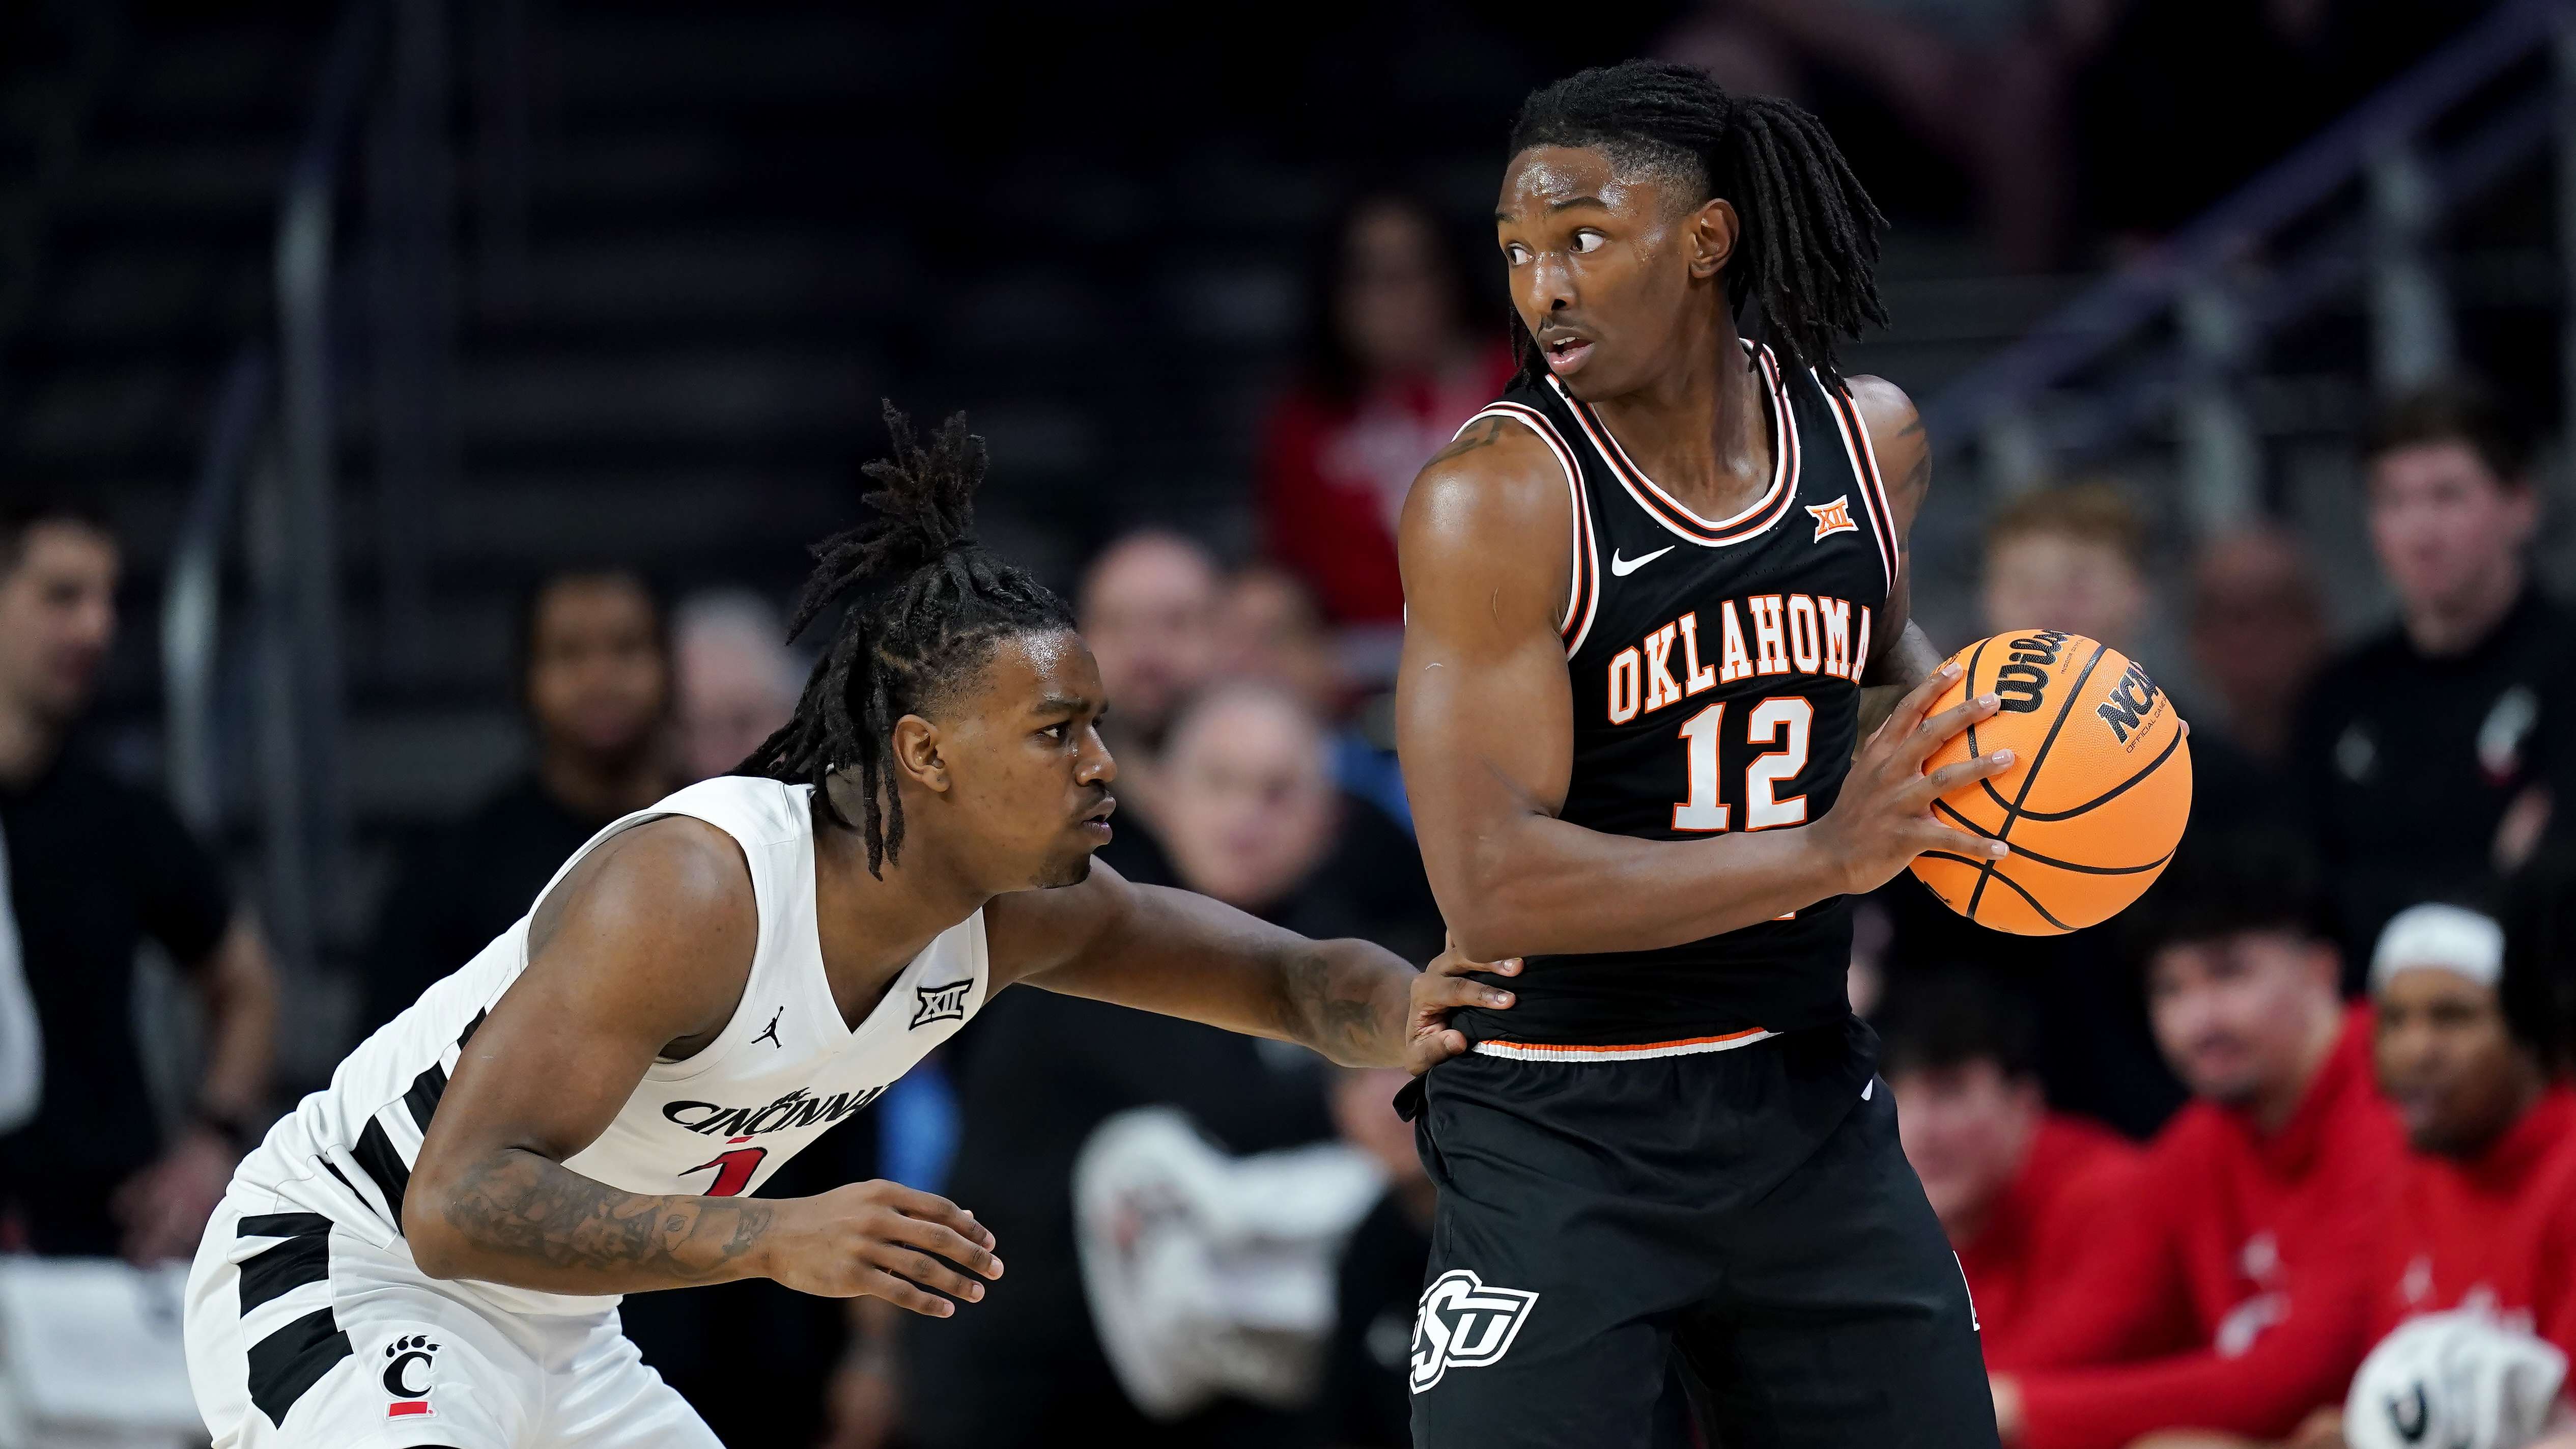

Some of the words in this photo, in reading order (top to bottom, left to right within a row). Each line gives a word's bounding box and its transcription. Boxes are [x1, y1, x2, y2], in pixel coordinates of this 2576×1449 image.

[1809, 499, 1855, 537] XII
[1608, 594, 1871, 725] OKLAHOMA
[1995, 629, 2073, 713] Wils
[2096, 661, 2159, 745] NCA
[2126, 719, 2156, 754] OFFICIAL
[1671, 696, 1814, 832] 12
[918, 982, 971, 1023] XII
[662, 1085, 890, 1136] CINCINNA
